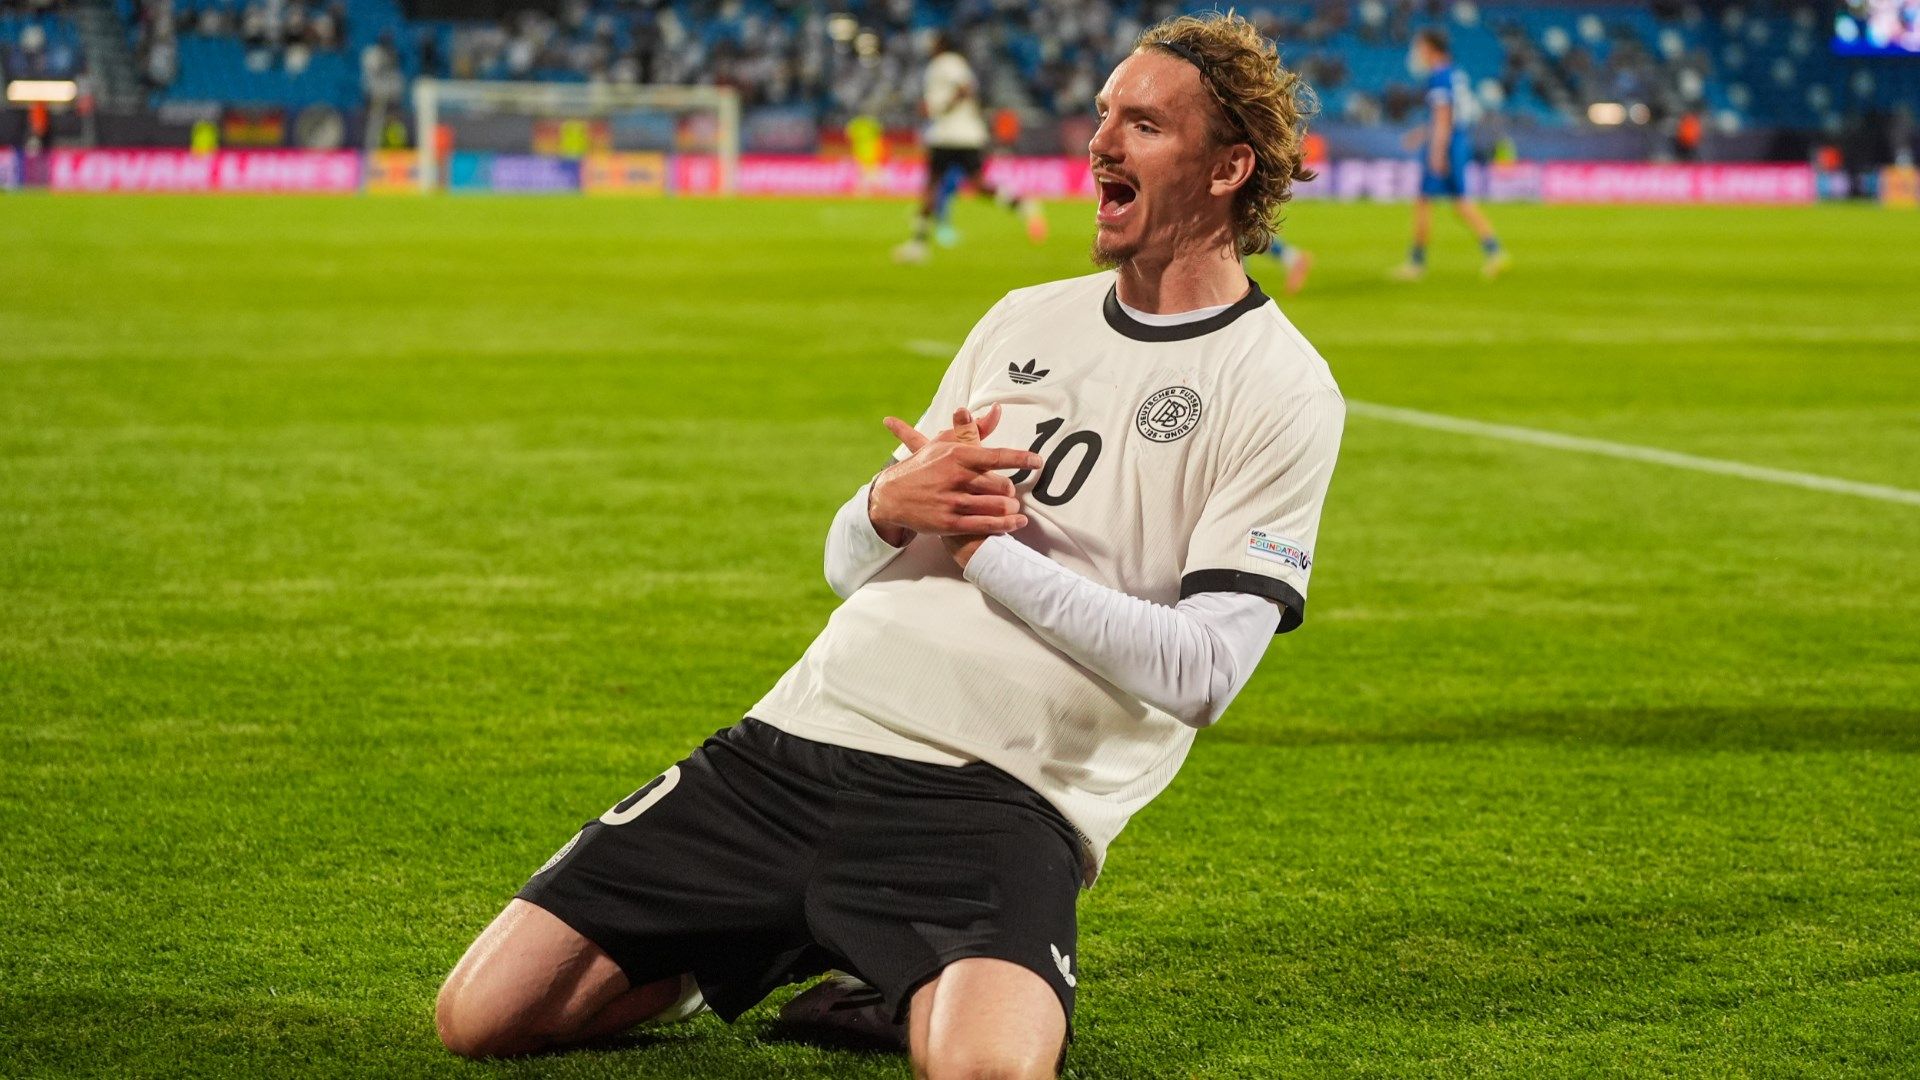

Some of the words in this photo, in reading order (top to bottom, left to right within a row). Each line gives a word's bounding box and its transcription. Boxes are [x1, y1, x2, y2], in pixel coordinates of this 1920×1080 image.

[1140, 389, 1176, 426] DEUTSCHER
[1008, 416, 1102, 506] 10
[1251, 530, 1267, 538] UEFA
